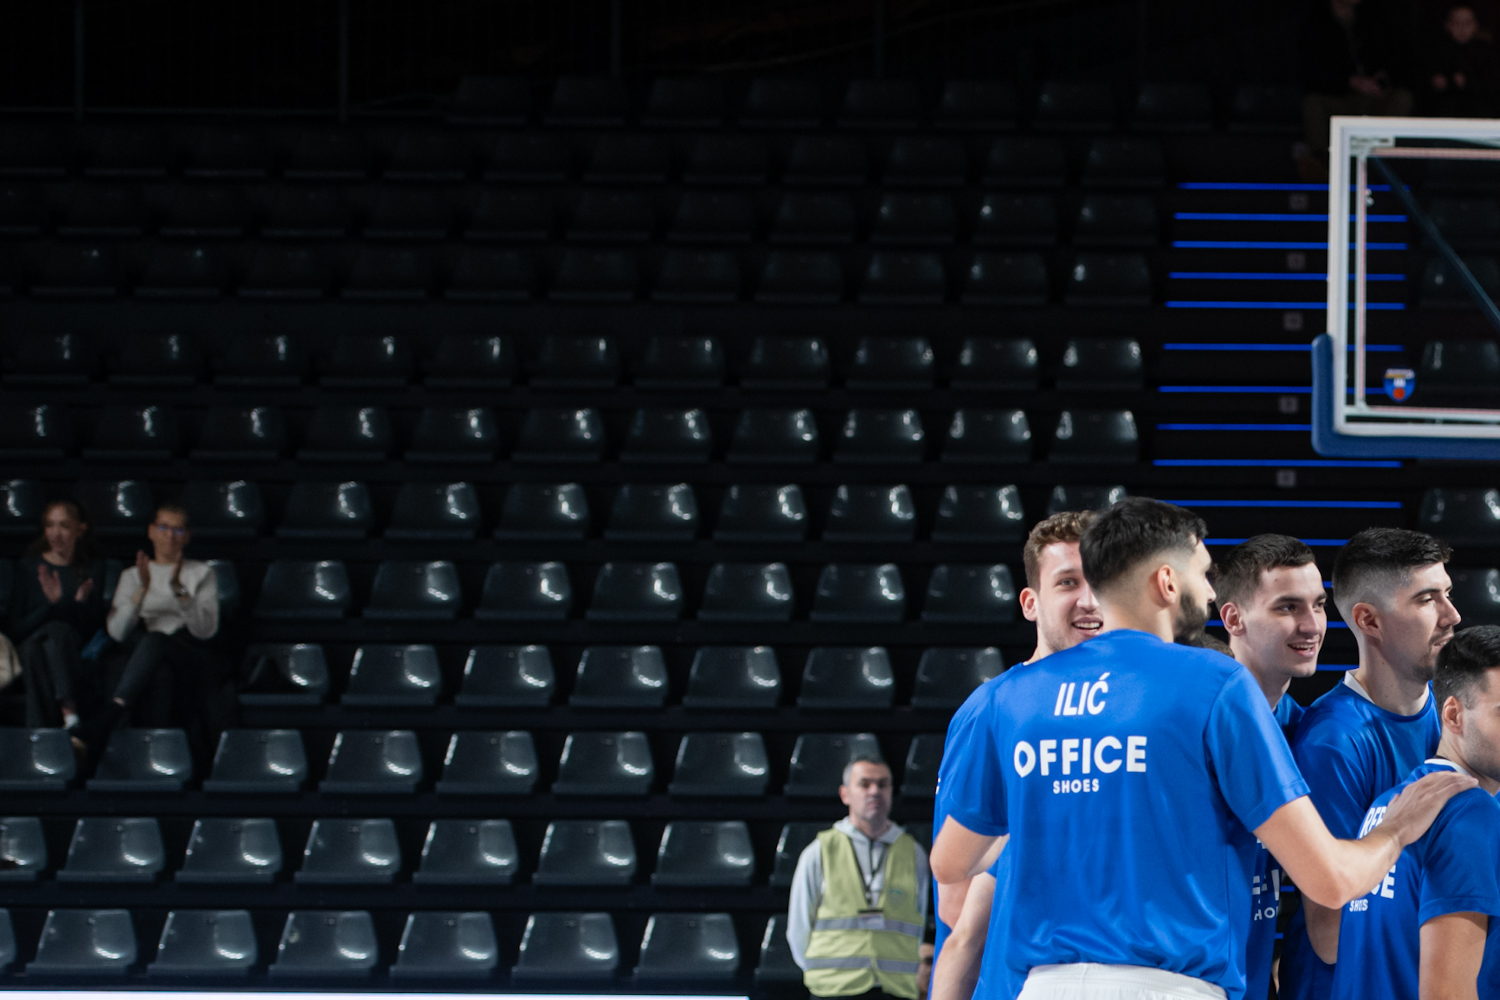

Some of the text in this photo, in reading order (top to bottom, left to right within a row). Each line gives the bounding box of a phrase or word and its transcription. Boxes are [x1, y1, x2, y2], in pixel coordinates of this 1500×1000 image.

[1053, 672, 1111, 717] ILIĆ
[1013, 735, 1148, 779] OFFICE
[1052, 778, 1100, 795] SHOES
